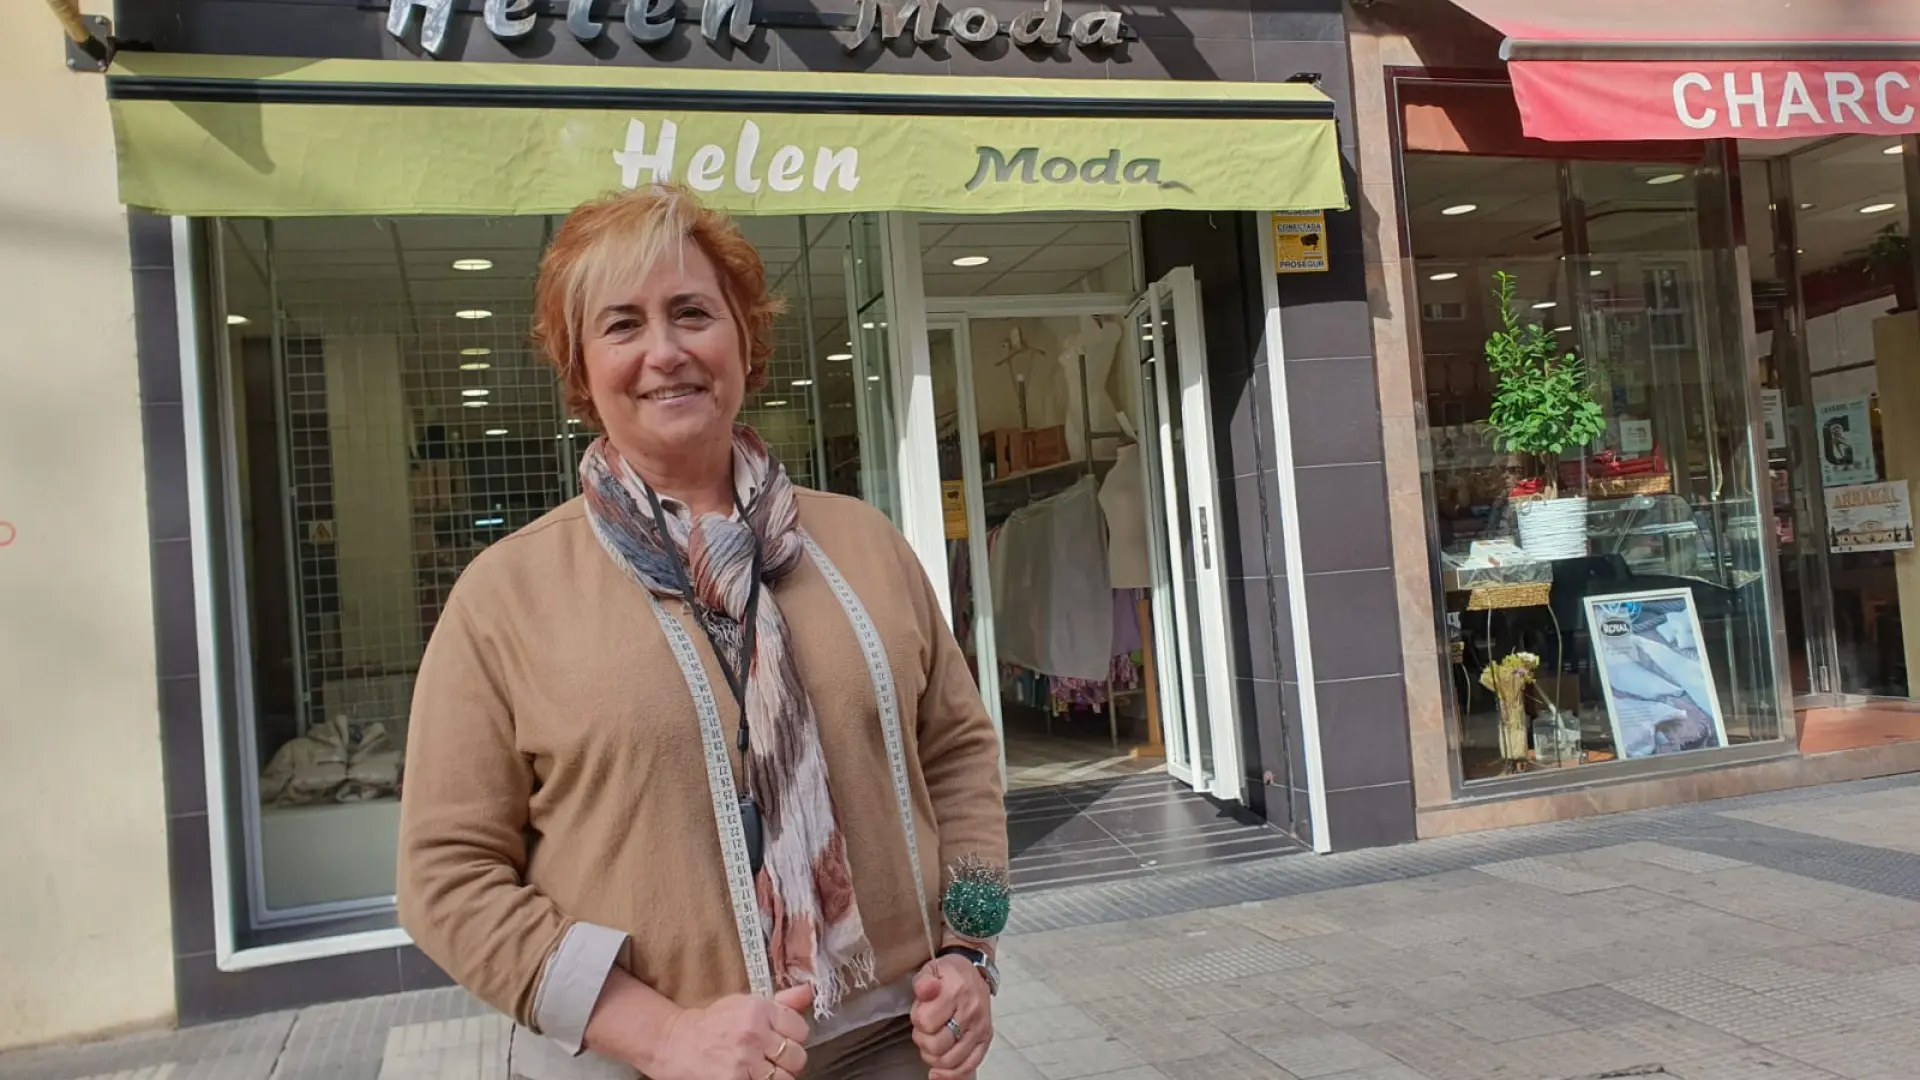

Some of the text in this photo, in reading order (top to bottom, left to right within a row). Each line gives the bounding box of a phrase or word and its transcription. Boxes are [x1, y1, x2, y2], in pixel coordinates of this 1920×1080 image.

[846, 0, 1125, 50] Moda
[1672, 71, 1920, 129] CHARC
[612, 117, 1163, 193] Helen Moda
[1279, 260, 1324, 269] PROSEGUR
[1602, 623, 1629, 635] ROYAL
